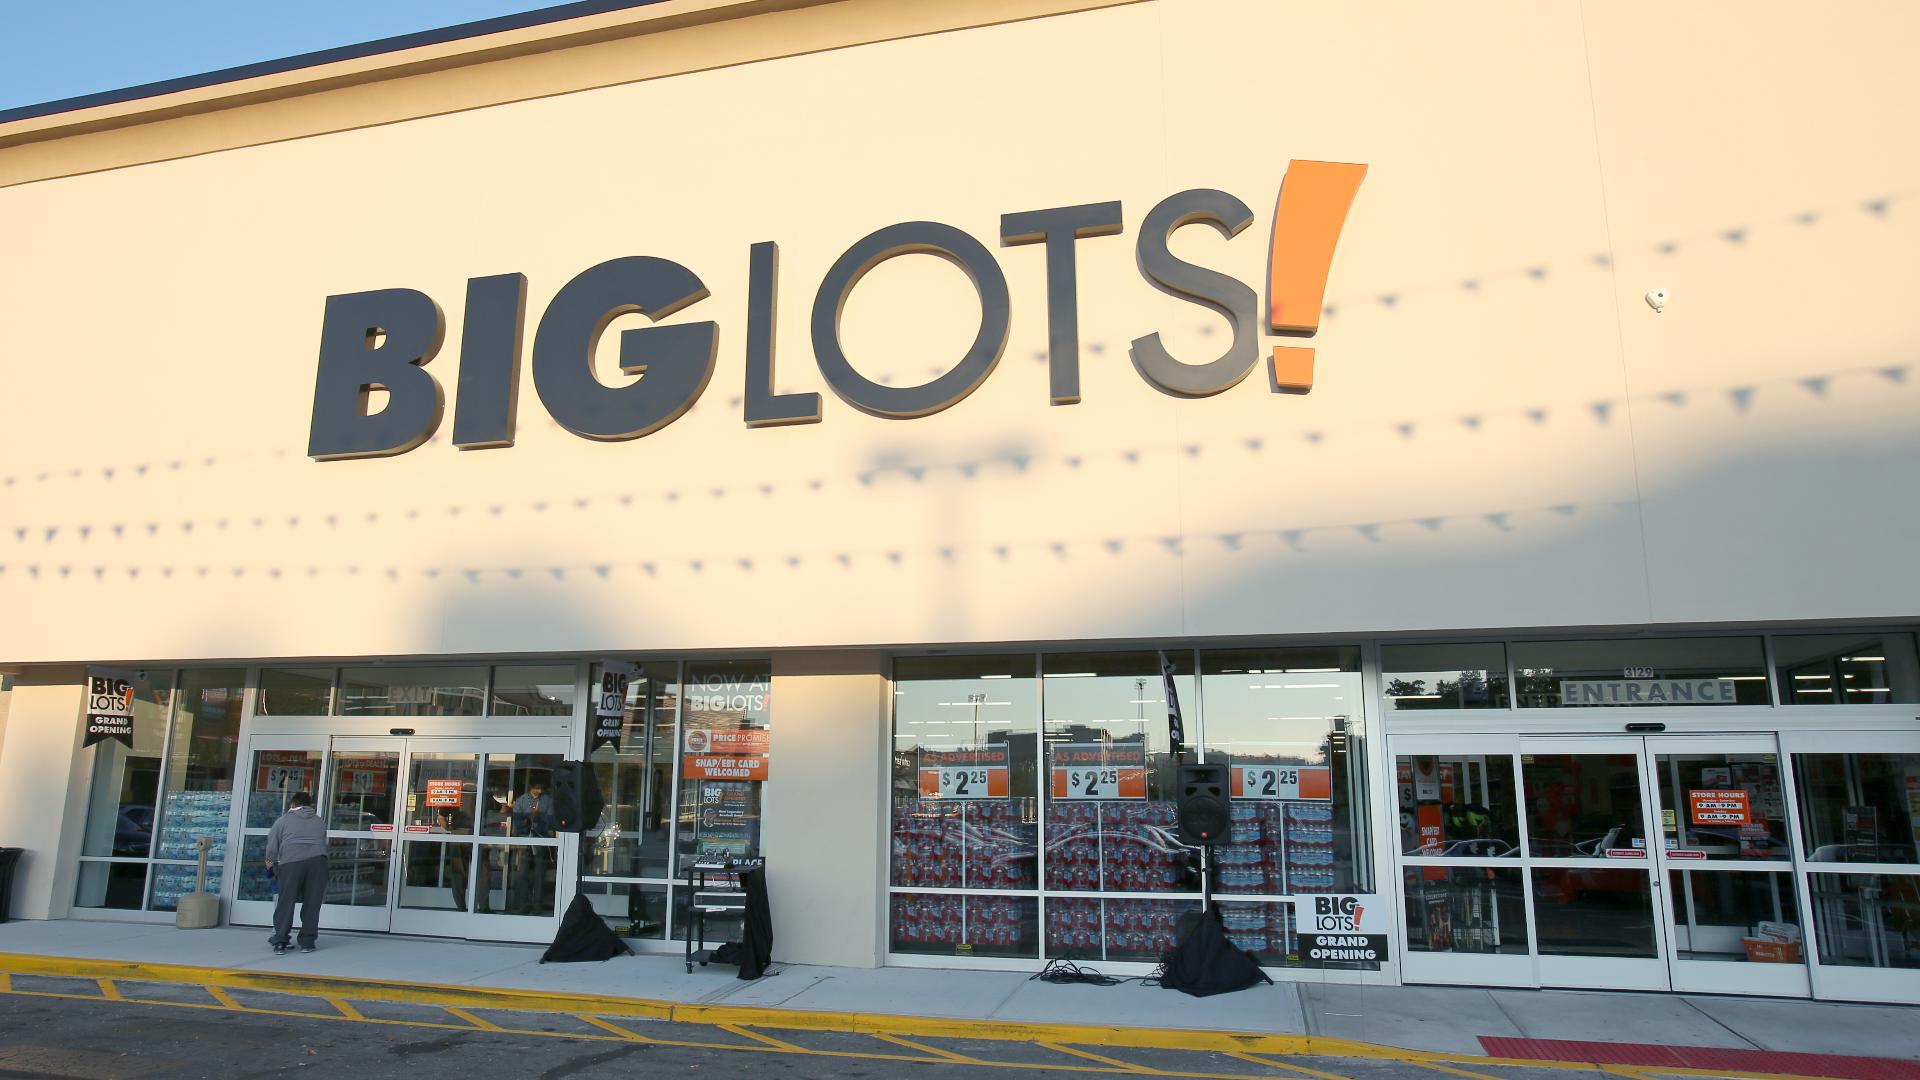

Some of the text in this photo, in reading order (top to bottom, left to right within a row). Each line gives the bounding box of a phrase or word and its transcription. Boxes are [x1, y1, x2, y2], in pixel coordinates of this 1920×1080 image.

[308, 159, 1368, 461] BIG LOTS!
[1625, 667, 1653, 678] 3129
[91, 676, 130, 696] BIG
[602, 671, 626, 694] BIG
[691, 673, 769, 692] NOW AT
[1564, 681, 1735, 701] ENTRANCE
[90, 687, 133, 711] LOTS!
[690, 695, 725, 711] BIG
[95, 716, 128, 725] GRAND
[602, 718, 620, 727] GRAN
[89, 725, 132, 734] OPENING
[713, 734, 737, 742] PRICE
[940, 751, 1005, 762] ADVERTISED
[1055, 751, 1140, 763] AS ADVERTISED
[695, 758, 760, 769] SNAP/EBT CARD
[704, 768, 750, 777] WELCOMED
[704, 787, 722, 797] BIG
[1314, 896, 1361, 916] BIG
[1316, 905, 1365, 931] LOTS!
[1315, 935, 1369, 947] GRAND
[1309, 948, 1377, 960] OPENING
